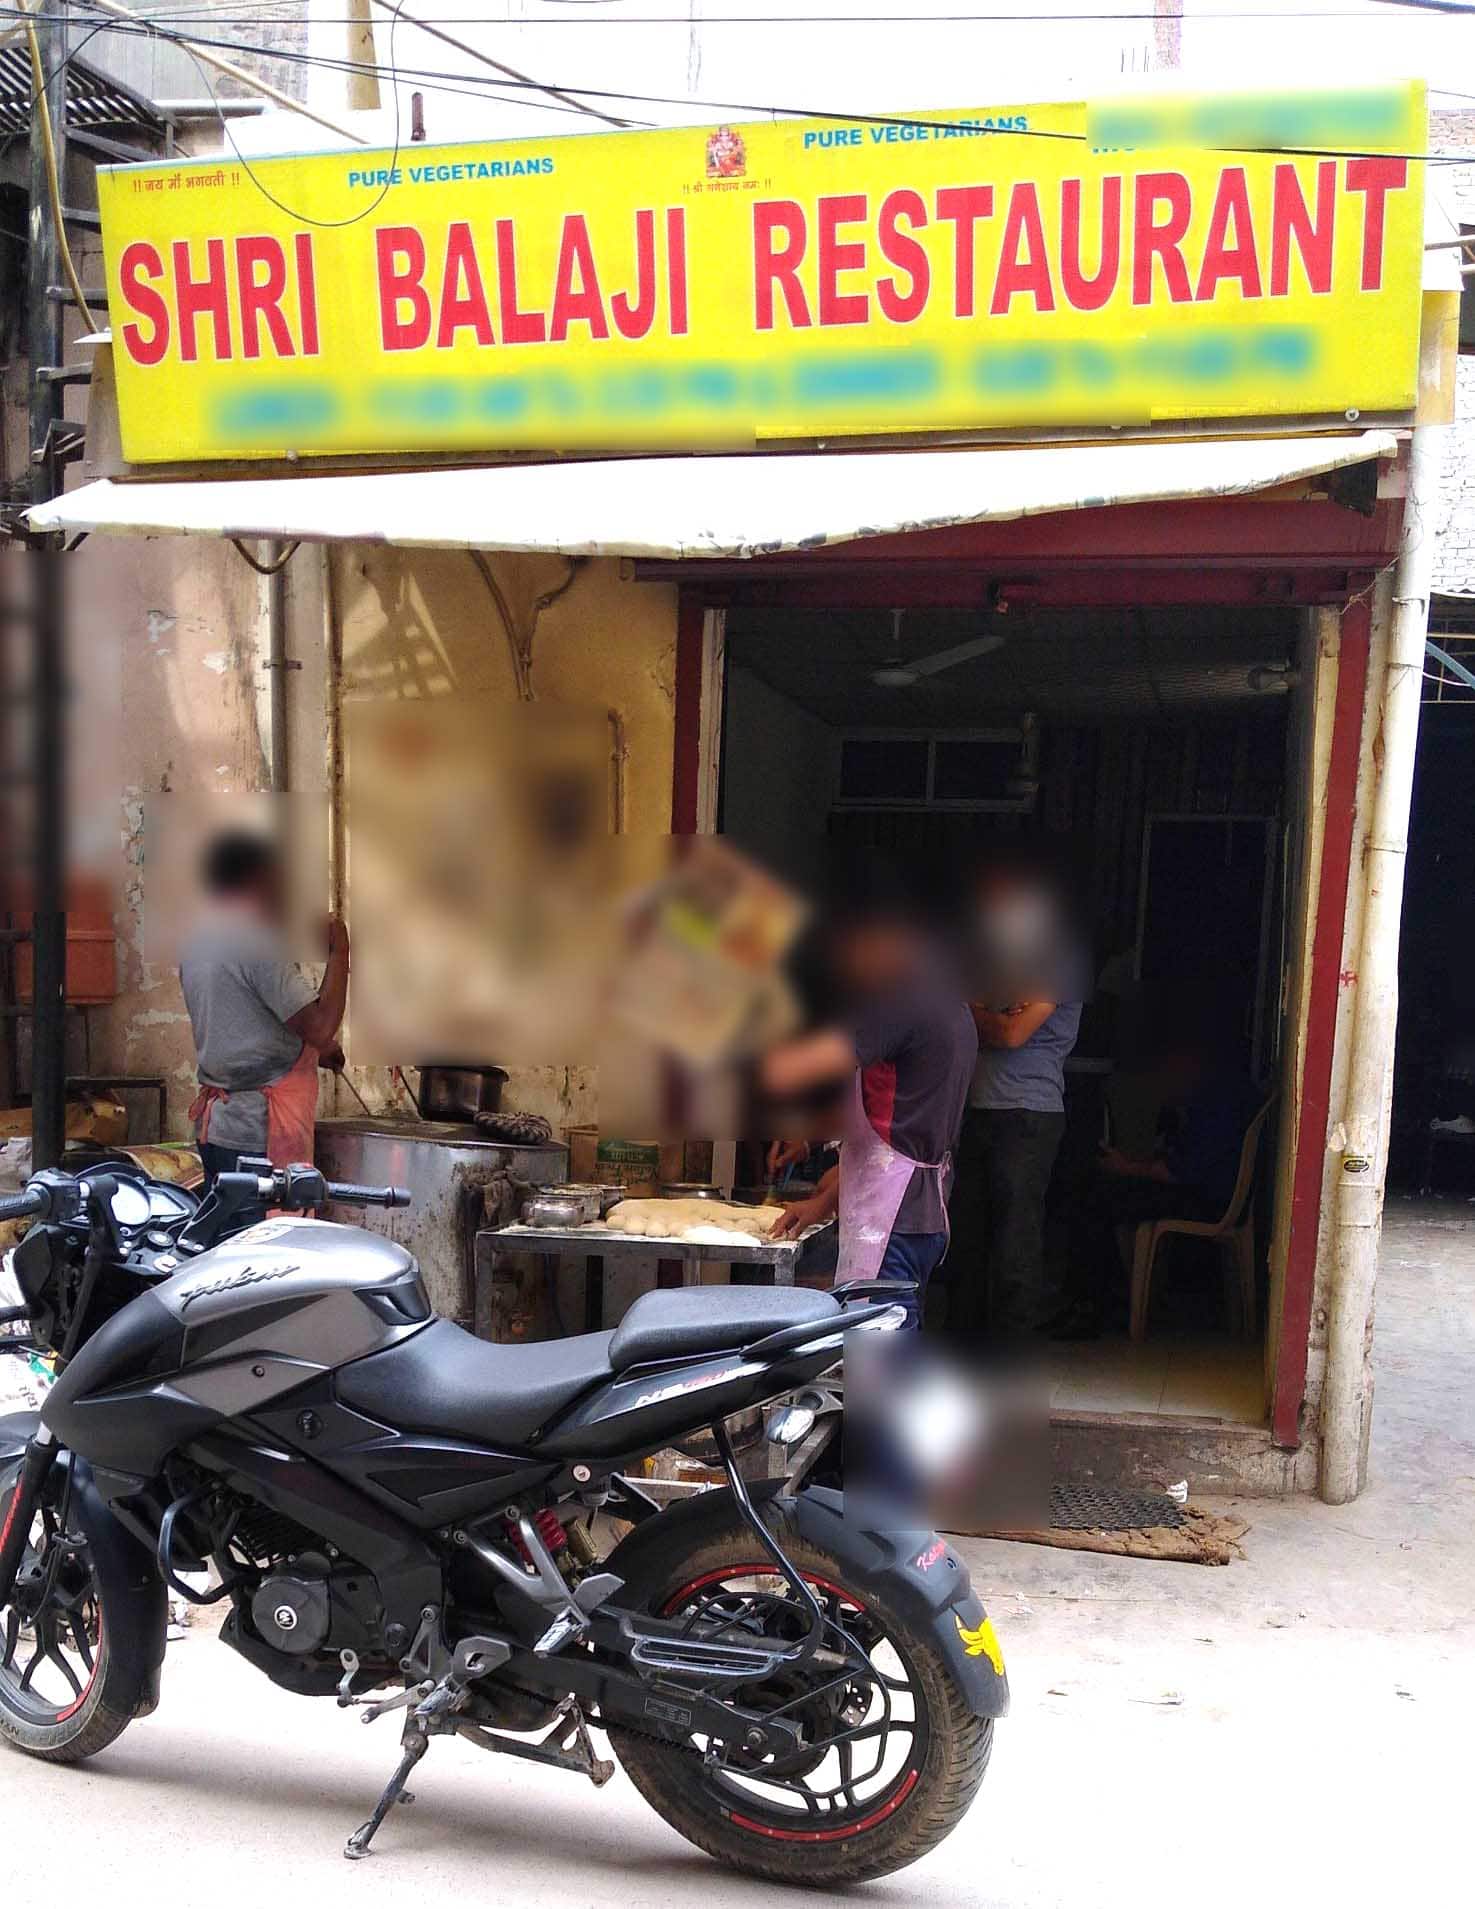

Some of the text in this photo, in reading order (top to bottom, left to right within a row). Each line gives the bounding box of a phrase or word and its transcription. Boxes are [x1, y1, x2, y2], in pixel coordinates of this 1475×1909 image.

[803, 128, 862, 149] PURE
[348, 157, 554, 188] PURE VEGETARIANS
[119, 157, 1409, 366] SHRI BALAJI RESTAURANT
